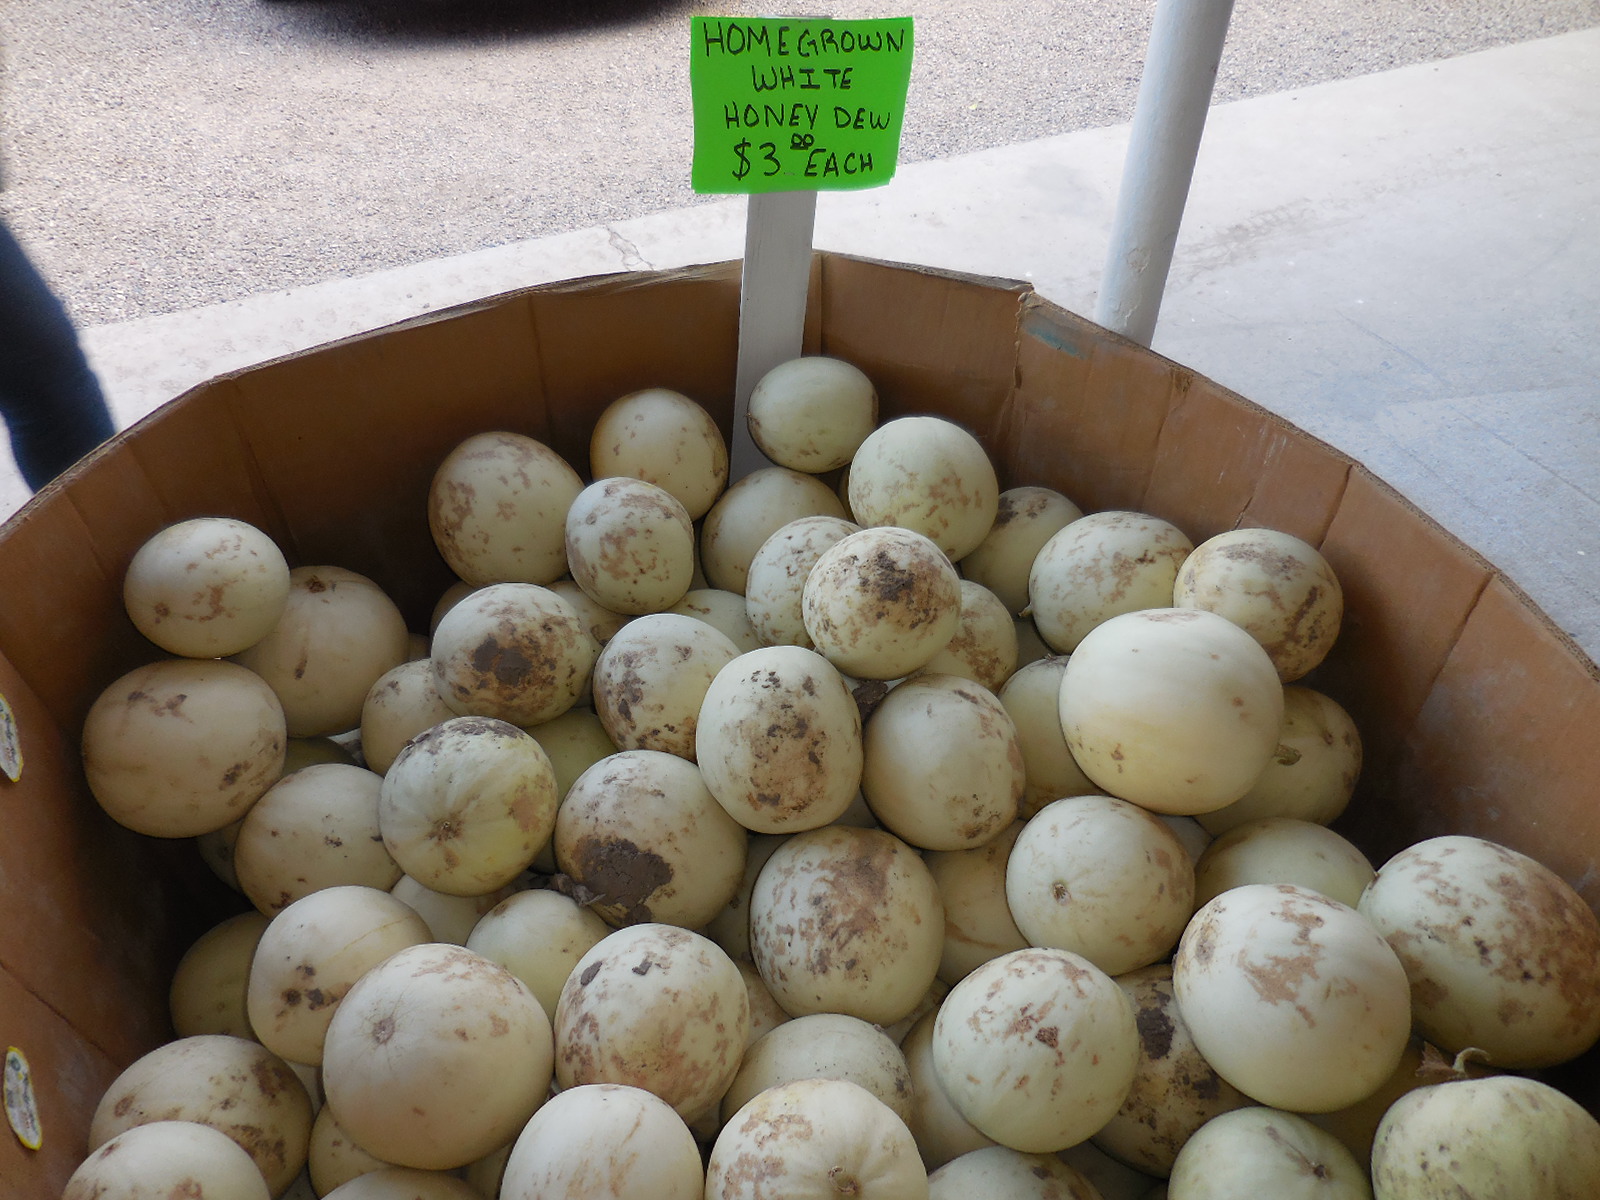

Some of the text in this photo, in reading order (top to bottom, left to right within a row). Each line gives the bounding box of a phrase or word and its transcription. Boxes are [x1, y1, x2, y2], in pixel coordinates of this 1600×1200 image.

[703, 22, 905, 57] HOMEGROWN
[751, 65, 853, 92] WHITE
[724, 101, 891, 130] HONEY DEW
[804, 148, 874, 178] EACH
